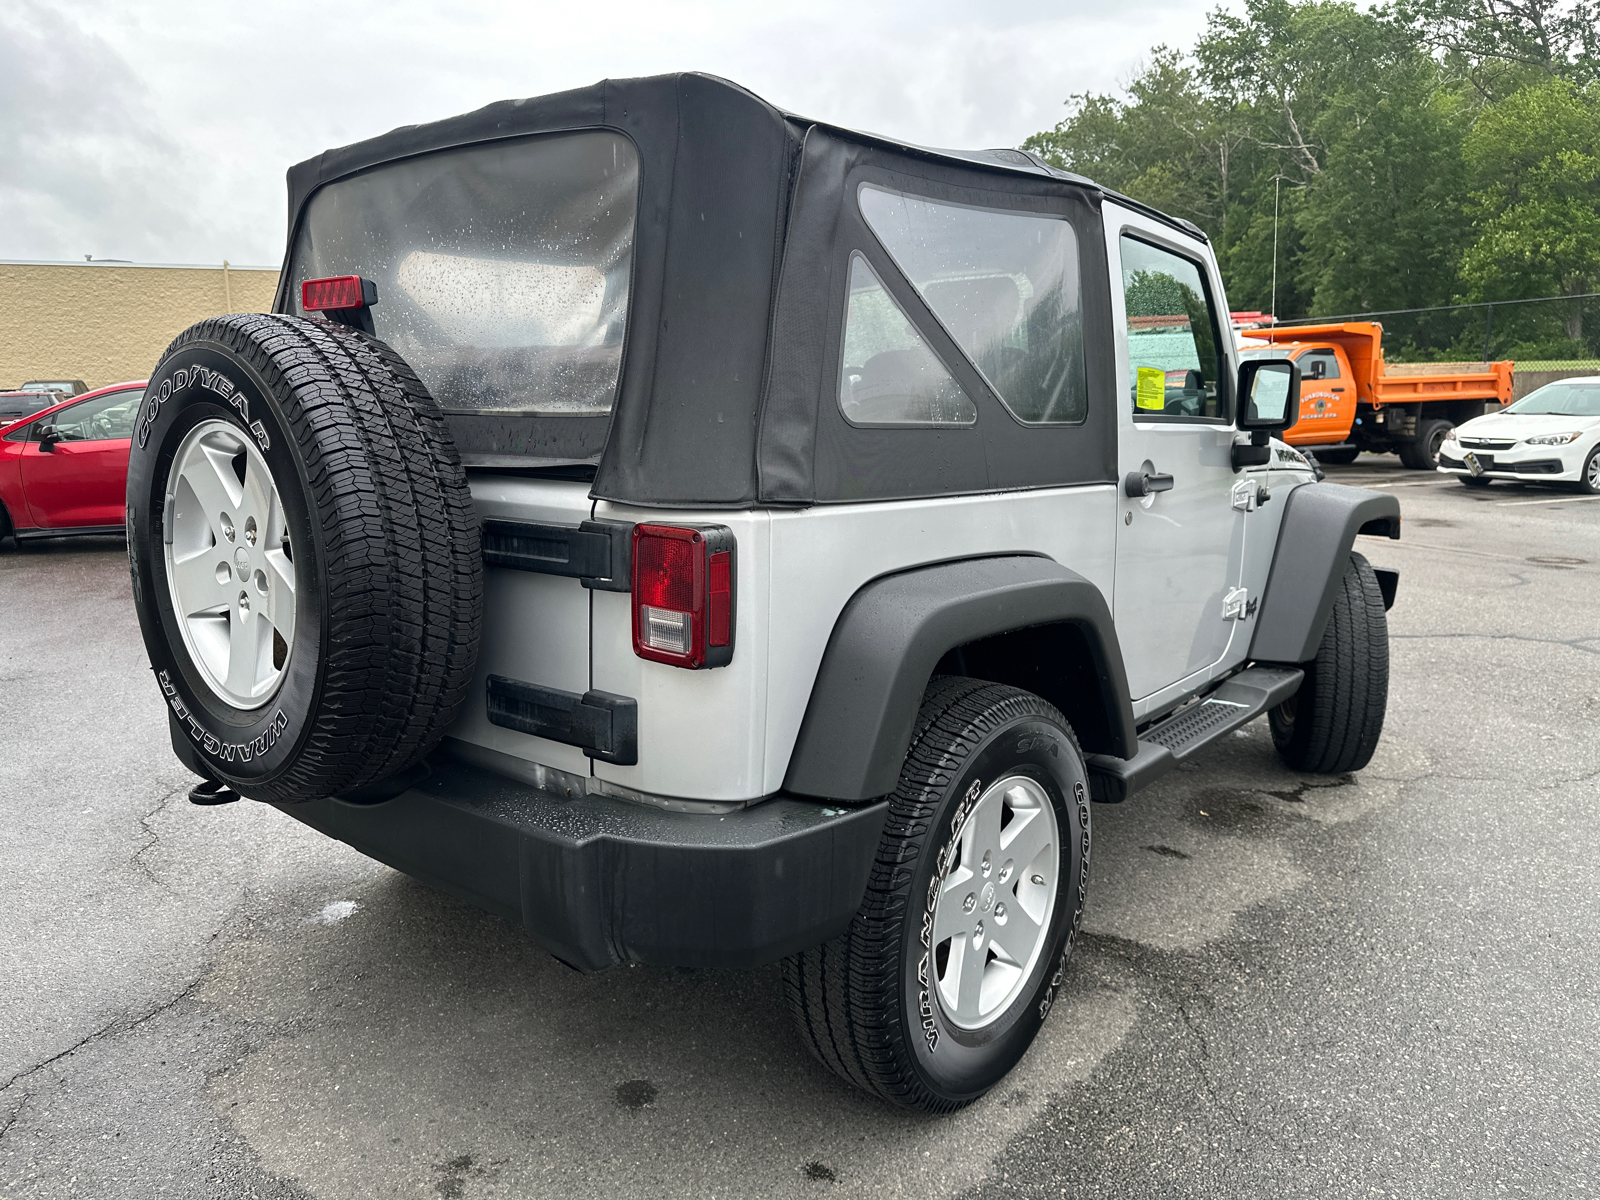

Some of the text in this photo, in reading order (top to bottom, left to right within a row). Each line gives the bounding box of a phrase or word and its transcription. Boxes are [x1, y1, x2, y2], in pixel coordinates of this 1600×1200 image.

[138, 364, 272, 452] GOODYEAR
[159, 669, 289, 763] WRANGLER
[917, 778, 981, 1053] WRANGLER
[1039, 781, 1090, 1021] GOODYEAR
